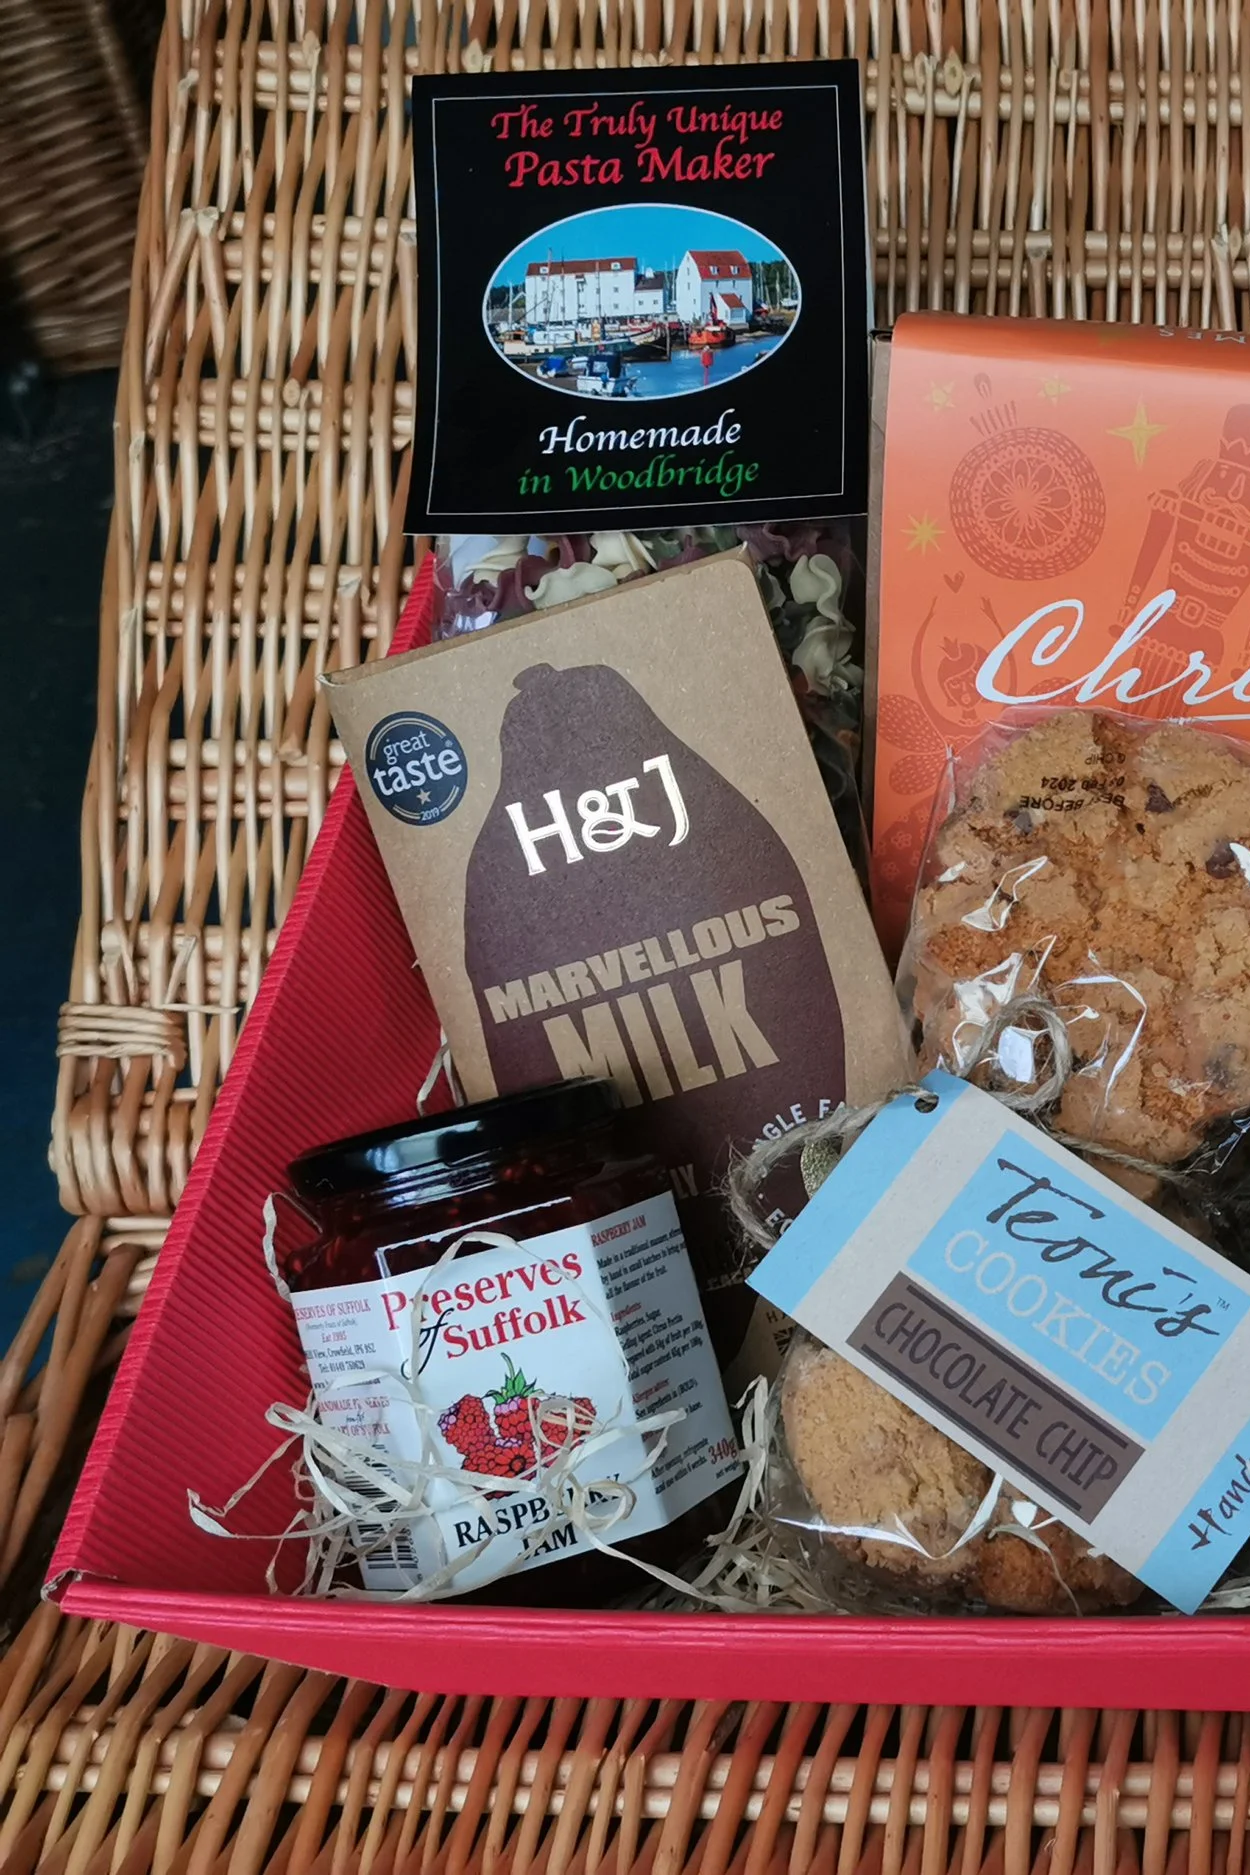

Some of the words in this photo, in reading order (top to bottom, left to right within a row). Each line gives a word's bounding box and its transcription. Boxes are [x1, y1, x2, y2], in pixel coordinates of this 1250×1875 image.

[491, 103, 553, 140] The
[564, 100, 656, 149] Truly
[667, 104, 783, 146] Unique
[504, 150, 624, 187] Pasta
[637, 135, 774, 184] Maker
[539, 407, 741, 455] Homemade
[517, 466, 552, 495] in
[568, 449, 760, 498] Woodbridge
[373, 748, 463, 797] taste
[383, 730, 431, 766] great
[1019, 795, 1085, 812] BEFORE
[1040, 776, 1077, 792] 2024
[420, 806, 441, 821] 2019
[504, 752, 692, 877] H&J
[483, 893, 801, 1025] MARVELLOUS
[542, 958, 781, 1110] MILK
[443, 1294, 587, 1360] Suffolk
[943, 1228, 1171, 1405] COOKIES
[874, 1301, 1042, 1440] CHOCOLATE
[1035, 1419, 1119, 1492] CHIP
[708, 1437, 738, 1466] 340g
[453, 1473, 621, 1549] RASPB
